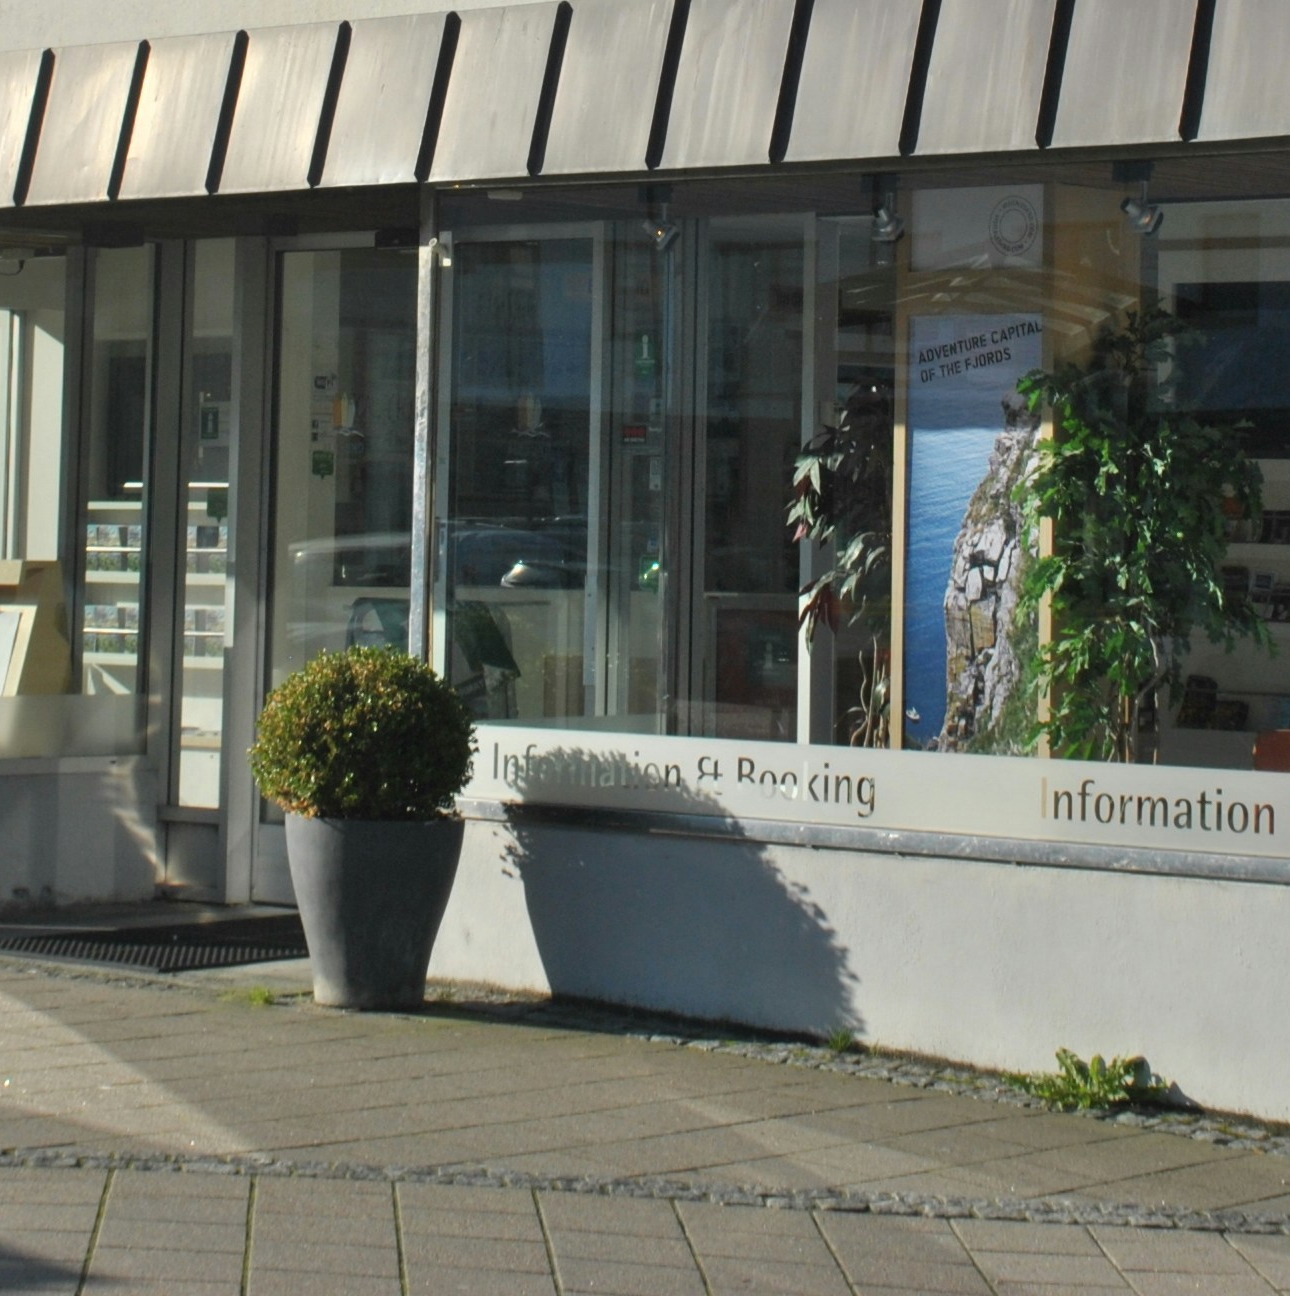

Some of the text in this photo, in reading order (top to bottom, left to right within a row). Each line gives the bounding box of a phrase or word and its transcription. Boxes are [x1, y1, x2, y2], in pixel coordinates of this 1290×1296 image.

[918, 320, 1043, 365] ADVENTURE CAPITAL
[920, 349, 1012, 384] OF THE FJORDS
[492, 742, 682, 789] Information
[737, 757, 877, 818] Booking
[1040, 777, 1276, 836] Information
